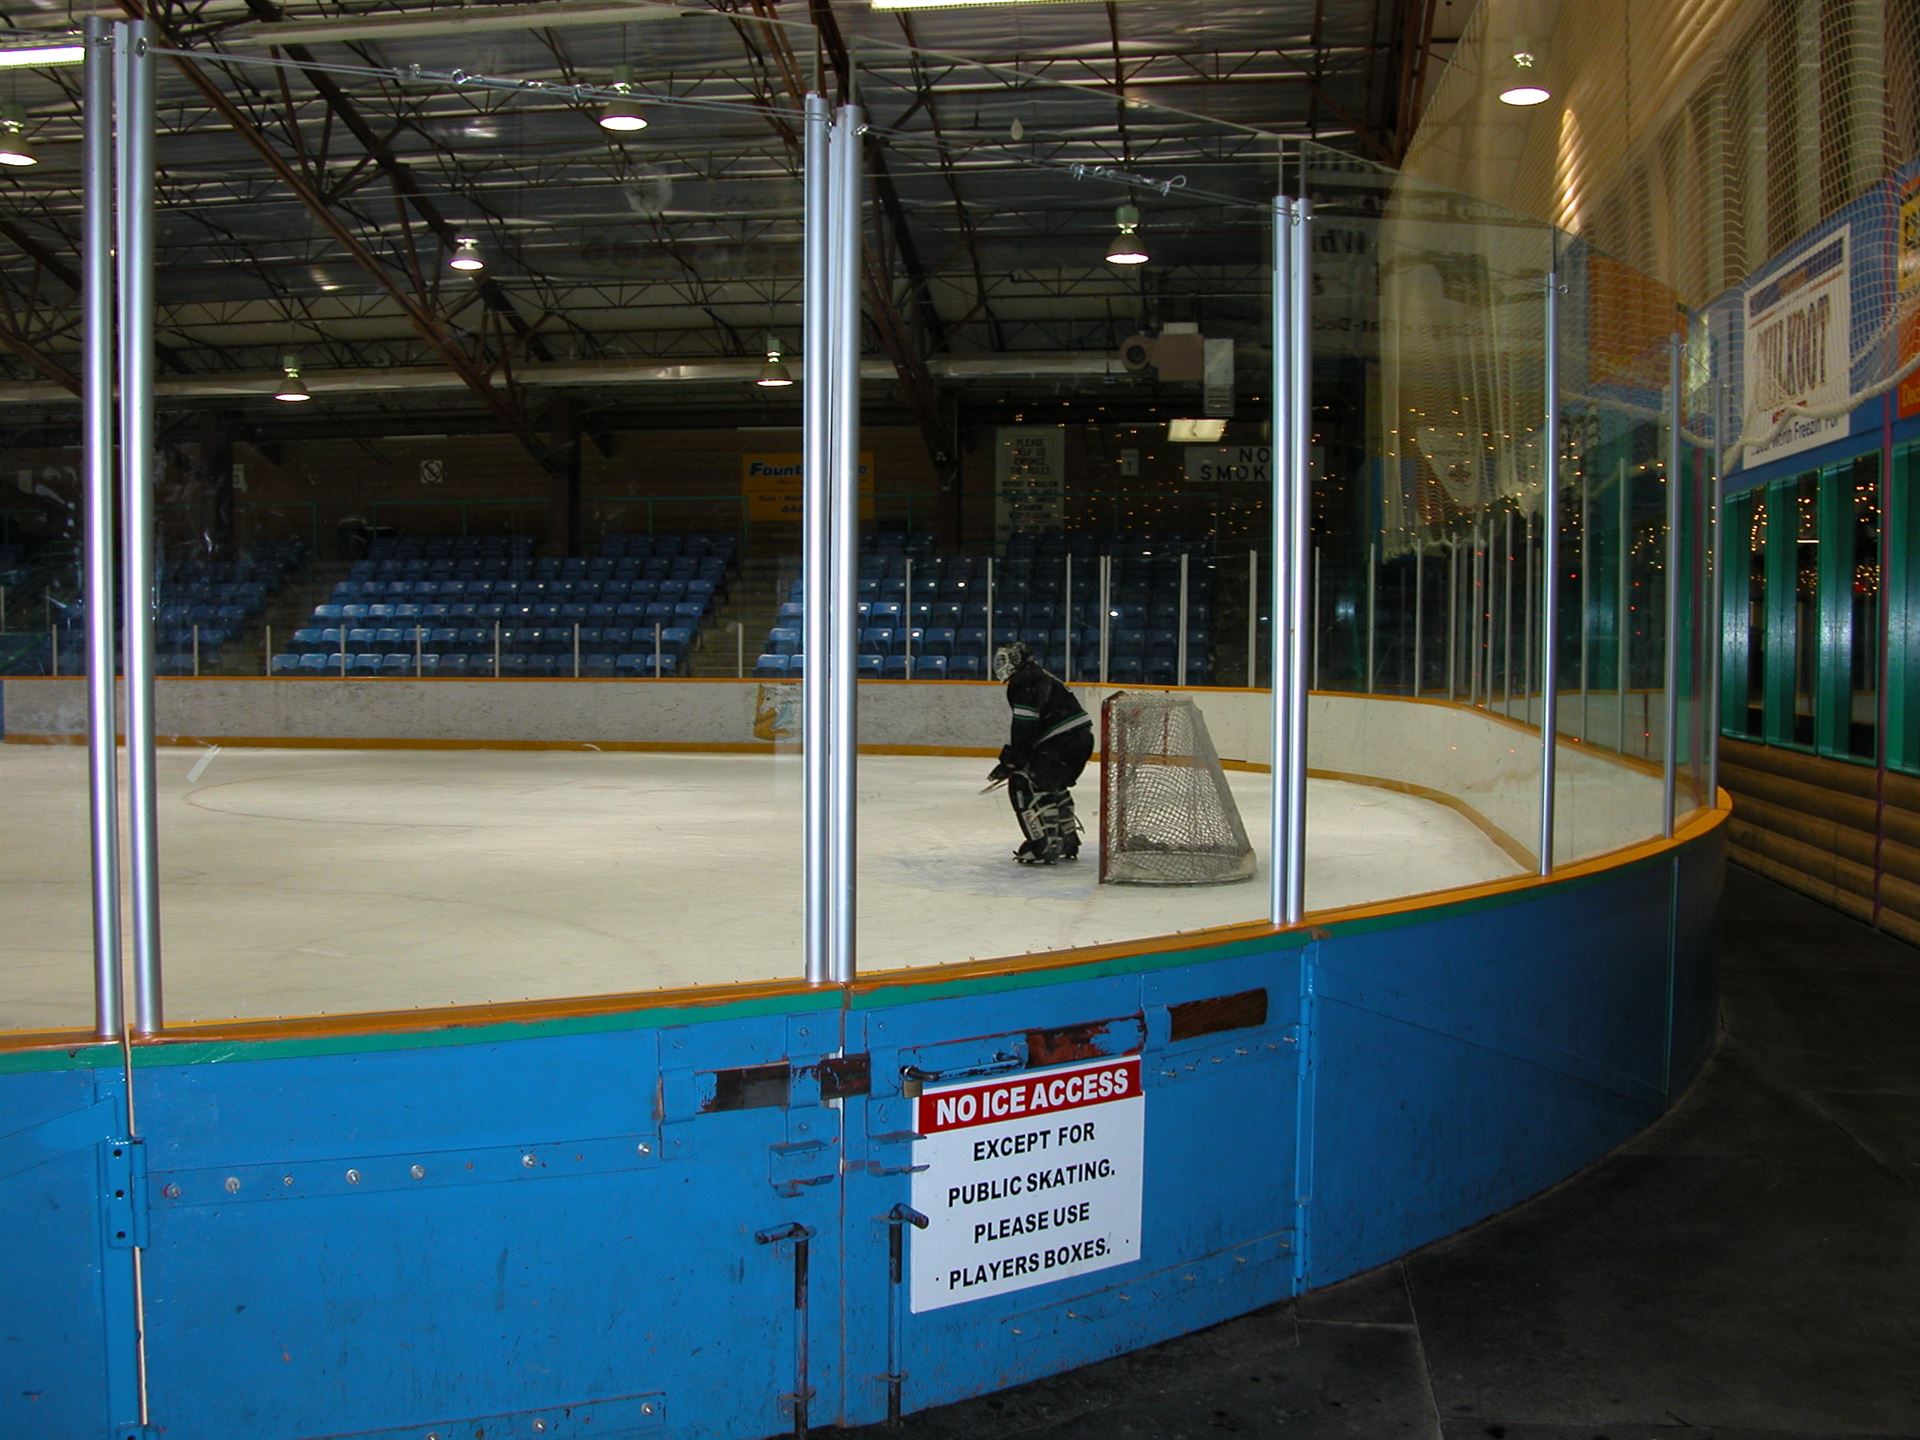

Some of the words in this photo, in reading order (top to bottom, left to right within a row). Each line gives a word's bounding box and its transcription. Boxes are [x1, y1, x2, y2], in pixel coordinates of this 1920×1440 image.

[749, 461, 804, 477] Fount
[1201, 465, 1266, 481] SMOK
[1239, 448, 1270, 463] NO
[937, 1095, 977, 1126] NO
[982, 1086, 1026, 1118] ICE
[1030, 1068, 1129, 1110] ACCESS
[973, 1130, 1051, 1162] EXCEPT
[1058, 1122, 1095, 1147] FOR
[948, 1175, 1022, 1208] PUBLIC
[1026, 1158, 1115, 1193] SKATING.
[974, 1212, 1049, 1244] PLEASE
[1053, 1202, 1090, 1227] USE
[949, 1252, 1040, 1290] PLAYERS
[1044, 1237, 1111, 1269] BOXES.
